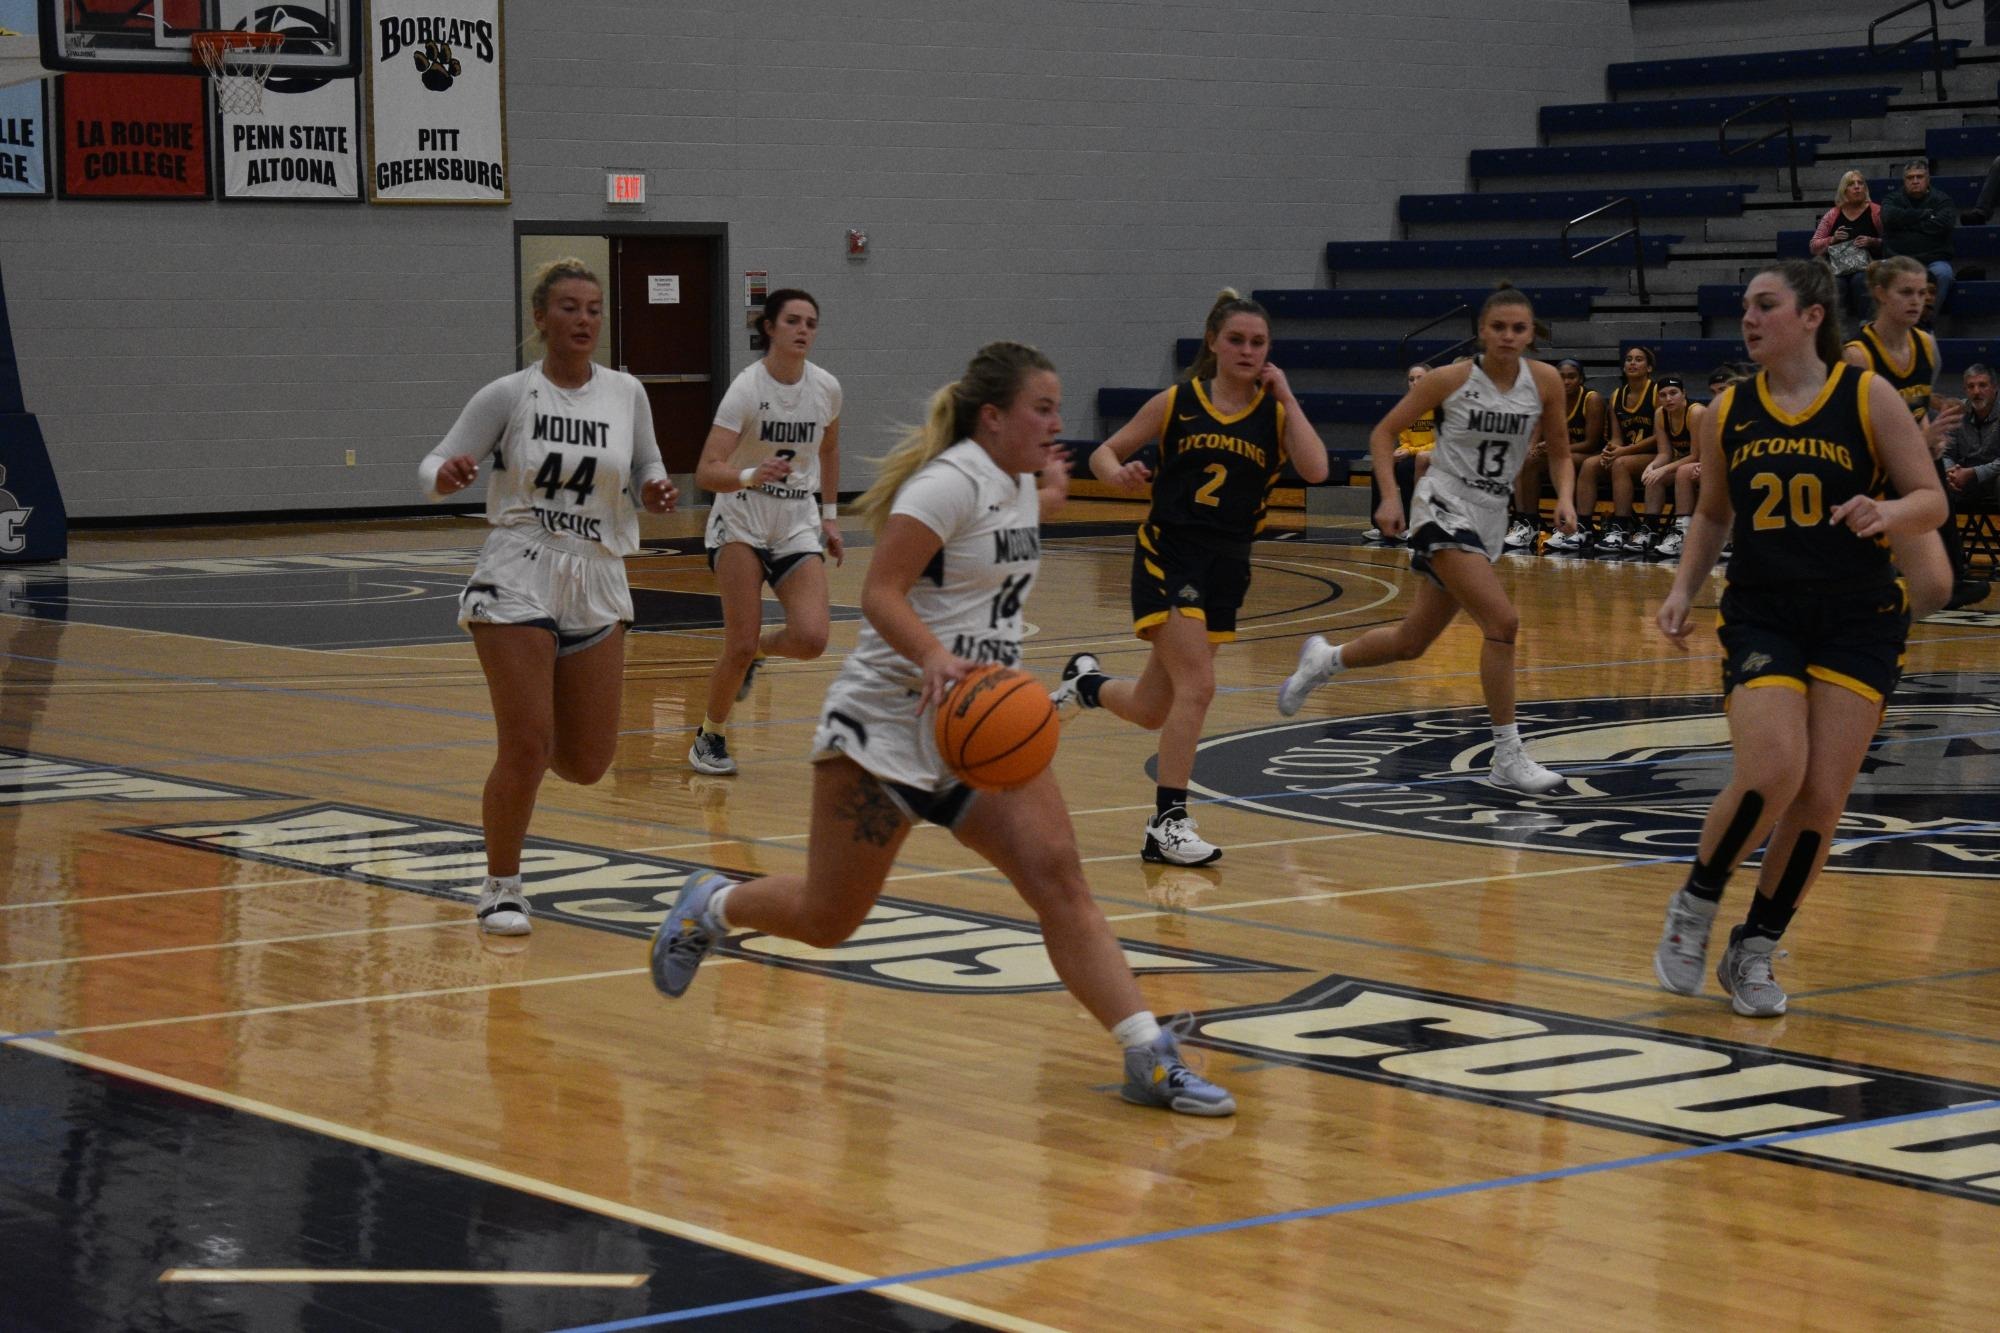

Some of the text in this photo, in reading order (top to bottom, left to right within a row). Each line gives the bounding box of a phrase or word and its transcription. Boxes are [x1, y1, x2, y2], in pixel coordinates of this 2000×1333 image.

[380, 16, 493, 63] BOBCATS
[77, 120, 193, 151] LA ROCHE
[233, 124, 348, 154] PENN STATE
[418, 128, 460, 151] PITT
[83, 151, 187, 182] COLLEGE
[247, 157, 337, 187] ALTOONA
[376, 157, 503, 191] GREENSBURG
[616, 176, 640, 199] EXIT
[532, 412, 609, 448] MOUNT
[760, 420, 816, 443] MOUNT
[1467, 408, 1530, 435] MOUNT
[1178, 433, 1265, 469] LYCOMING
[1477, 440, 1510, 477] 13
[1731, 437, 1853, 471] LYCOMING
[534, 452, 598, 506] 44
[1195, 463, 1228, 507] 2
[1750, 472, 1823, 531] 20
[990, 573, 1031, 629] 16
